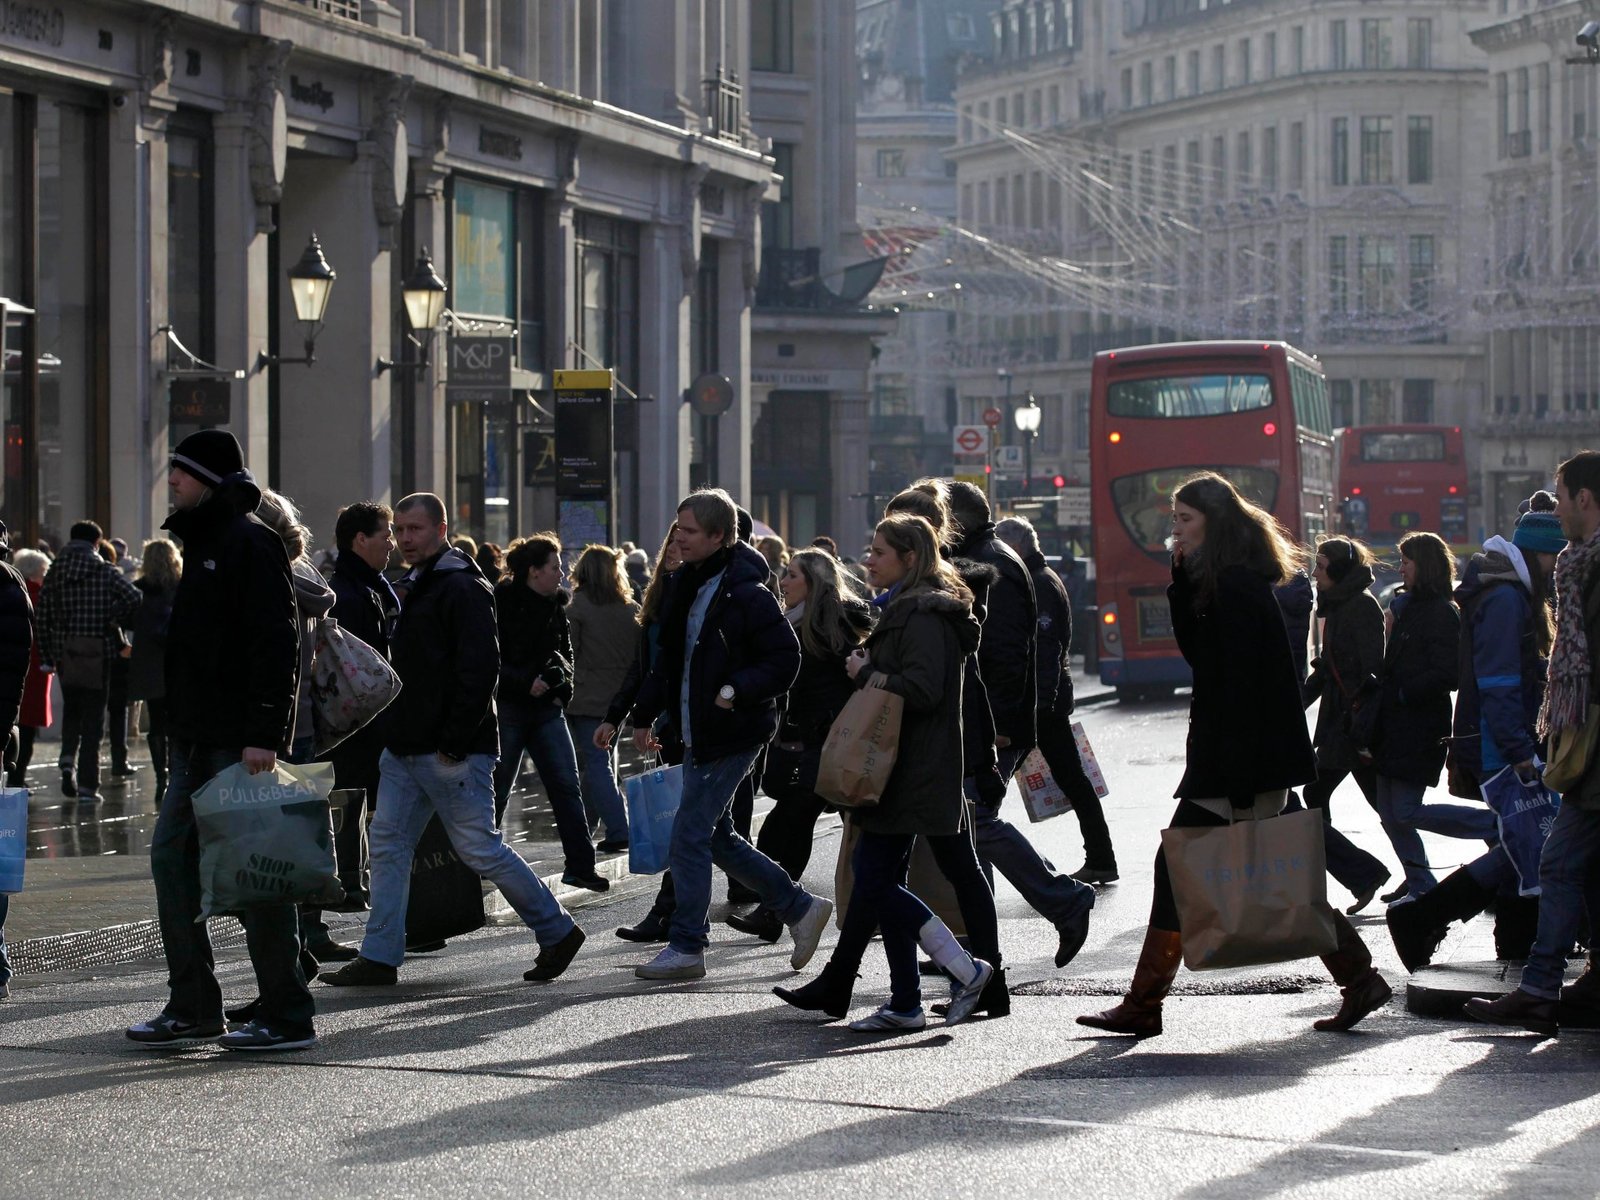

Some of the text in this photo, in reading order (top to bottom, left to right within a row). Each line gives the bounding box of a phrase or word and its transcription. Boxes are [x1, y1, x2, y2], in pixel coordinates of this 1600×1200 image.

[453, 343, 504, 370] M&P
[863, 705, 891, 777] PRIMARK
[218, 779, 318, 806] PULL&BEAR
[247, 852, 296, 877] SHOP
[235, 869, 297, 894] ONLINE
